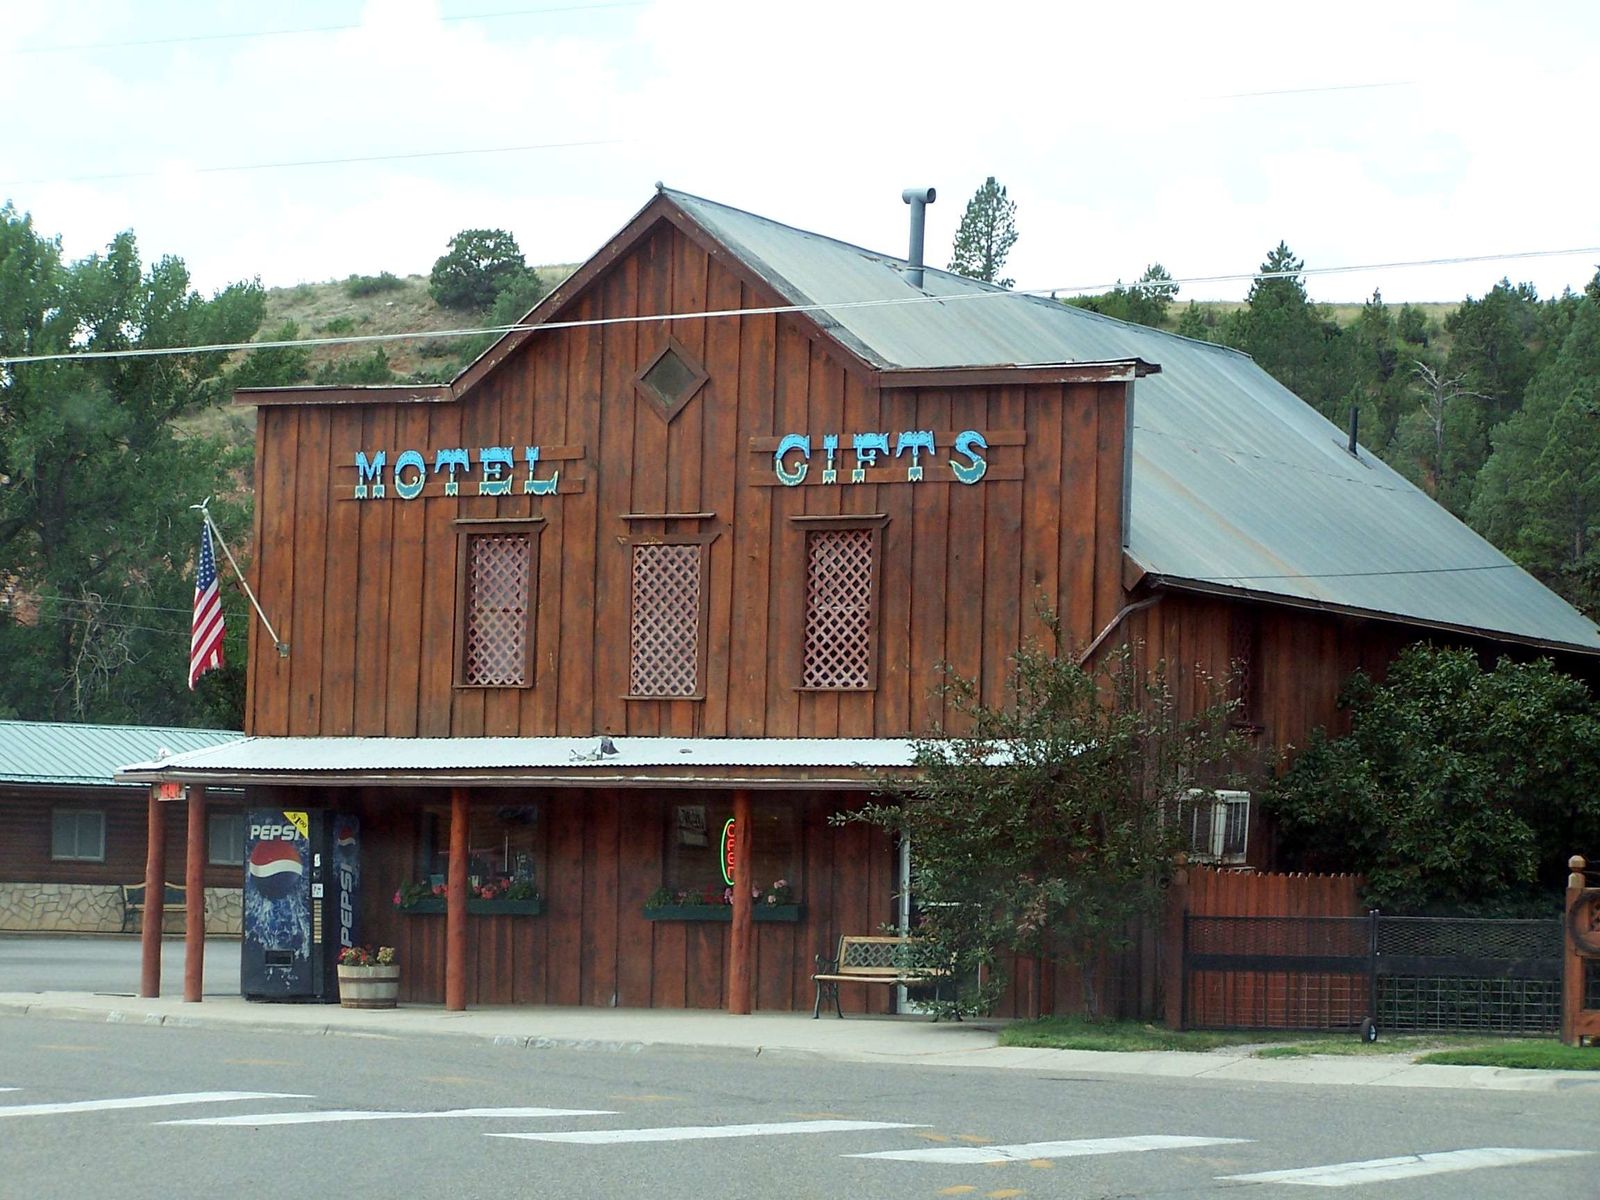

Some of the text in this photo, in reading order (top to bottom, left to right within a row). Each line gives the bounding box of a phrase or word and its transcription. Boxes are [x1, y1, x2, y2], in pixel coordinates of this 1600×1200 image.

[354, 445, 560, 500] MOTEL
[774, 430, 989, 486] GIFTS
[250, 824, 300, 841] PEPSI
[340, 863, 353, 948] PEPSI
